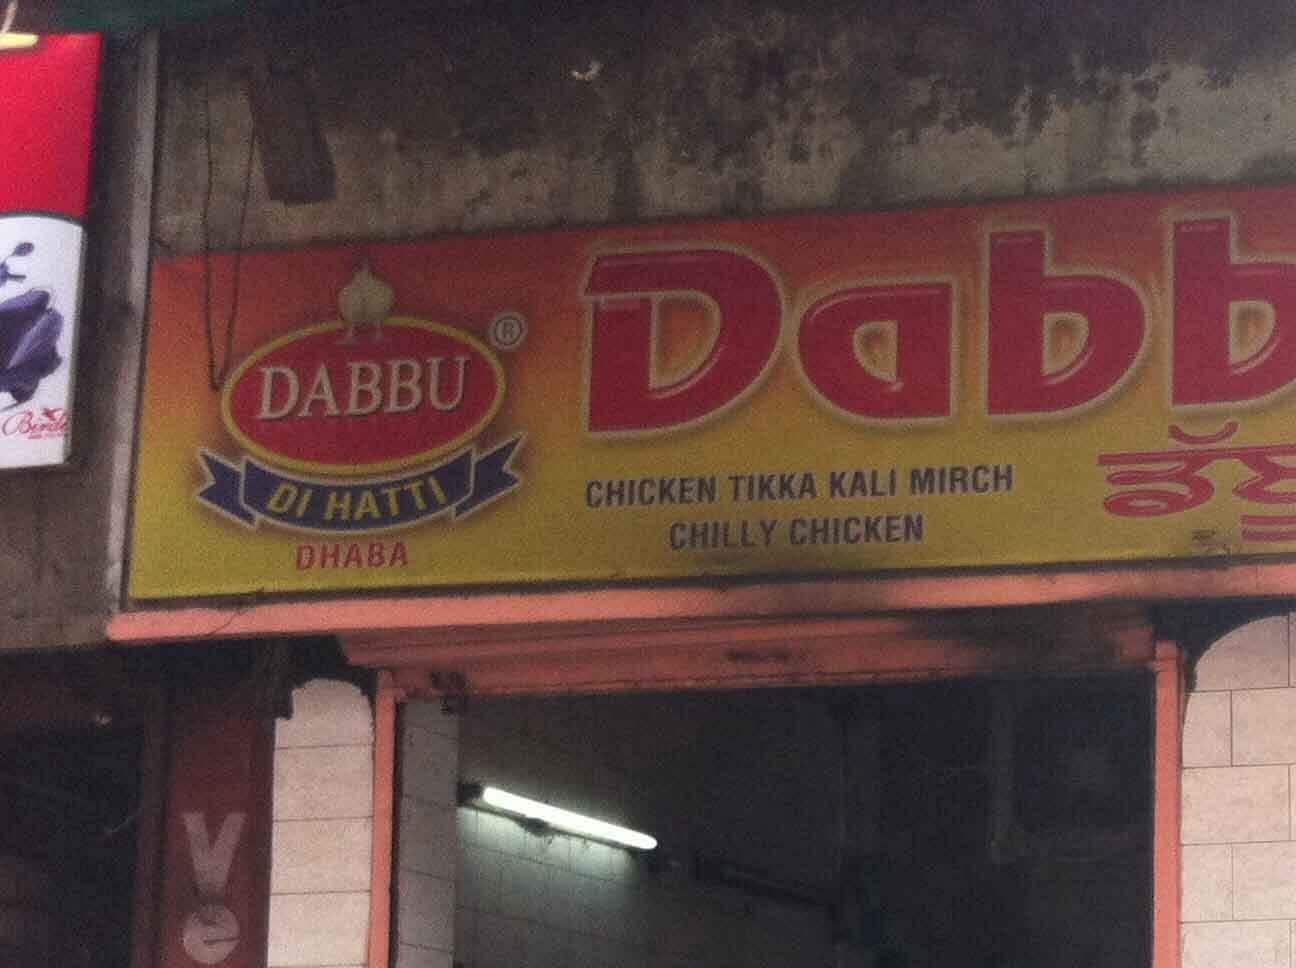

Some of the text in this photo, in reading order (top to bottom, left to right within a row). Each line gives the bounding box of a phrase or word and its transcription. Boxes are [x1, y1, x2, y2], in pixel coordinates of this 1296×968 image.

[257, 354, 472, 421] DABBU
[266, 476, 448, 521] DI HATTI
[585, 464, 1015, 508] CHICKEN TIKKA KALI MIRCH
[669, 513, 925, 551] CHILLY CHICKEN
[294, 540, 409, 571] DHABA
